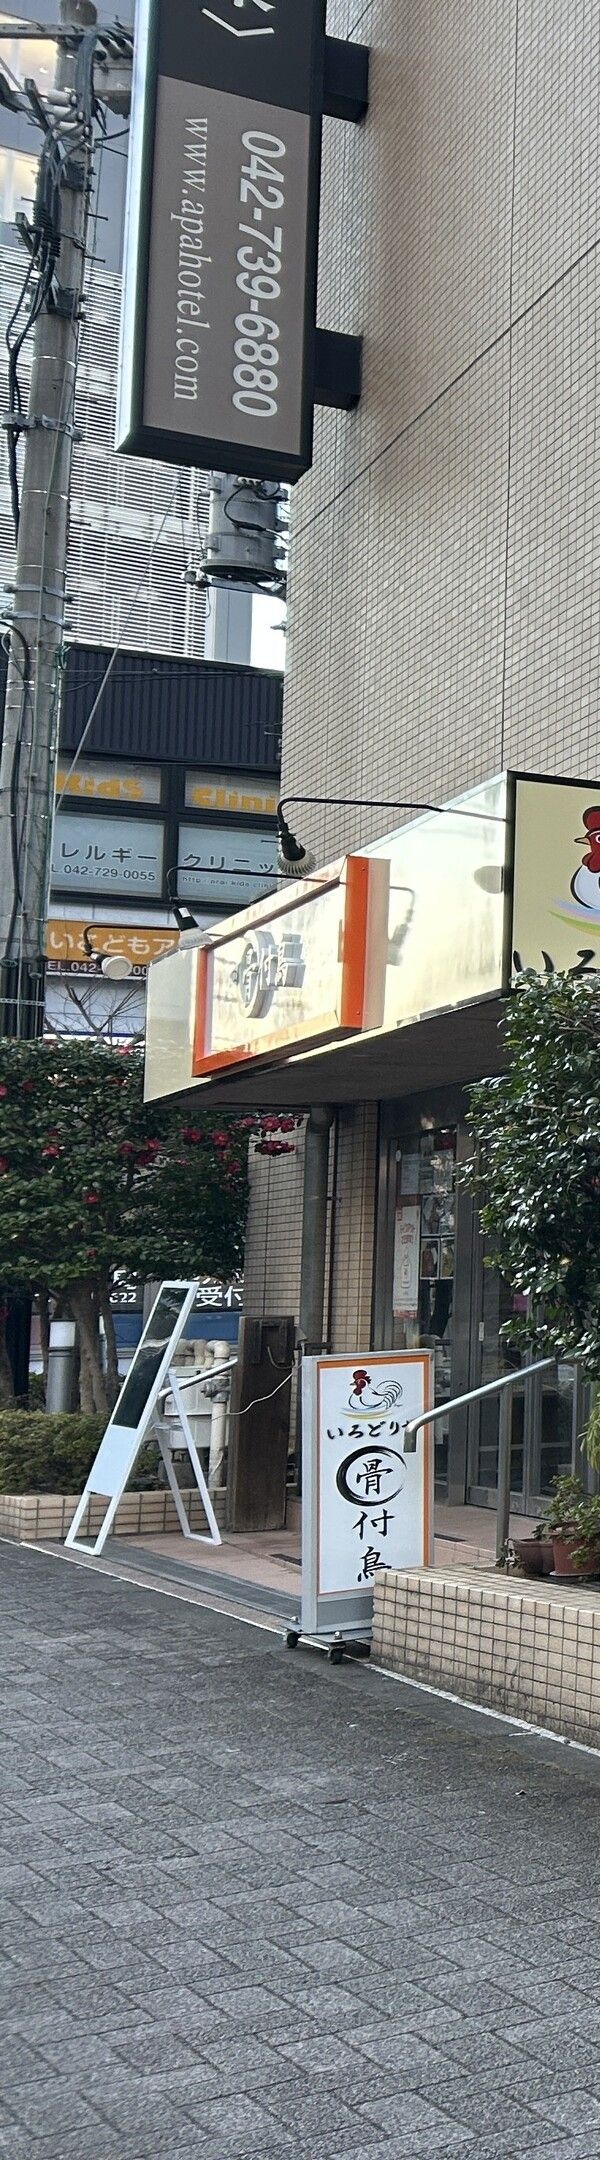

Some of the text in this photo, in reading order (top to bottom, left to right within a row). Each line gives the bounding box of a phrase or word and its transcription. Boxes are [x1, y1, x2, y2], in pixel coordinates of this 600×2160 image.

[170, 116, 214, 402] www.apahotel.com
[231, 129, 287, 418] 042-739-6880
[326, 1420, 410, 1440] いろどり
[351, 1458, 395, 1584] 骨付鳥
